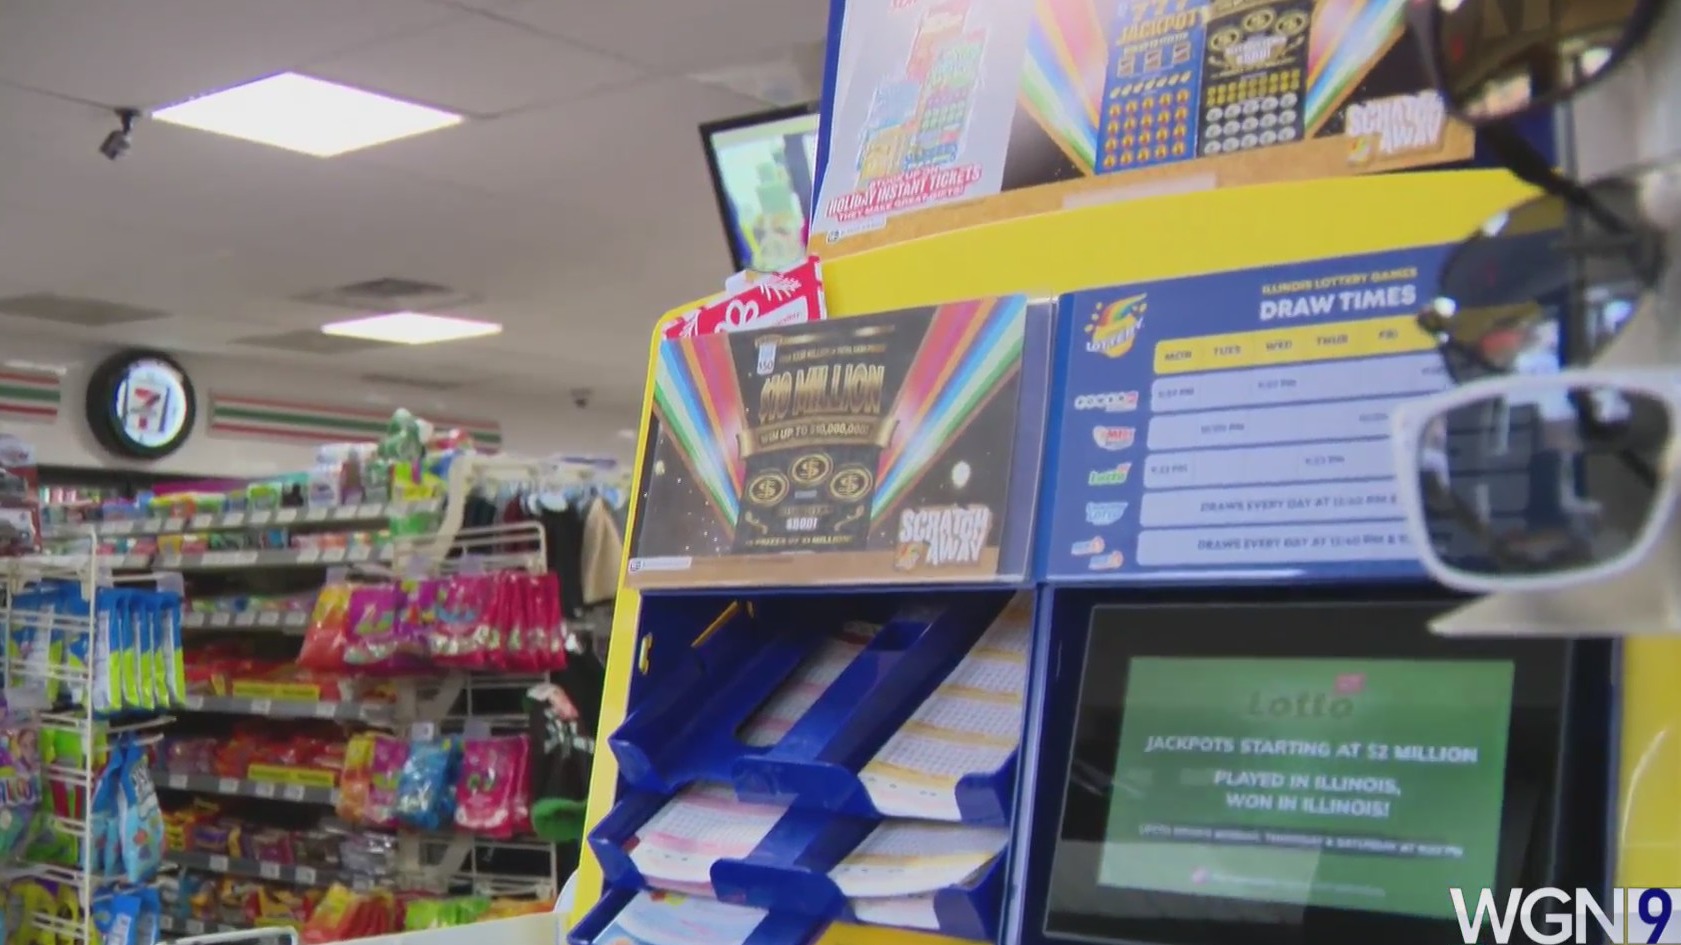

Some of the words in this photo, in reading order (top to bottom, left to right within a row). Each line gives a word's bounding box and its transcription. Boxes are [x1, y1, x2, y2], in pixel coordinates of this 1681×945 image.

[828, 190, 877, 217] HOLIDAY
[877, 177, 928, 202] INSTANT
[929, 164, 983, 188] TICKETS
[1262, 279, 1312, 295] ILLINOIS
[1315, 274, 1367, 289] LOTTERY
[1370, 267, 1417, 283] GAMES
[1259, 294, 1336, 321] DRAW
[1339, 284, 1416, 311] TIMES
[1086, 317, 1145, 353] LOTTERY
[1165, 350, 1192, 361] MON
[1213, 345, 1241, 355] TUES
[1265, 340, 1292, 350] WED
[793, 363, 885, 416] MILLION
[780, 427, 794, 439] UP
[1200, 501, 1244, 512] DRAWS
[1247, 500, 1283, 511] EVERY
[1287, 498, 1311, 509] DAY
[1315, 497, 1329, 508] AT
[901, 506, 991, 543] SCRATCH
[926, 532, 983, 565] AWAY
[1198, 538, 1241, 550] DRAWS
[1244, 537, 1280, 549] EVERY
[1283, 536, 1308, 548] DAY
[1311, 536, 1326, 547] AT
[1249, 690, 1353, 719] Lotto
[1145, 735, 1233, 753] JACKPOTS
[1240, 738, 1331, 759] STARTING
[1339, 743, 1359, 759] AT
[1367, 743, 1389, 760] $2
[1394, 744, 1478, 764] MILLION
[1213, 769, 1285, 789] PLAYED
[1290, 772, 1309, 790] IN
[1315, 775, 1401, 796] ILLINOIS,
[1225, 793, 1273, 811] WON
[1278, 795, 1297, 812] IN
[1303, 797, 1390, 818] ILLINOIS!
